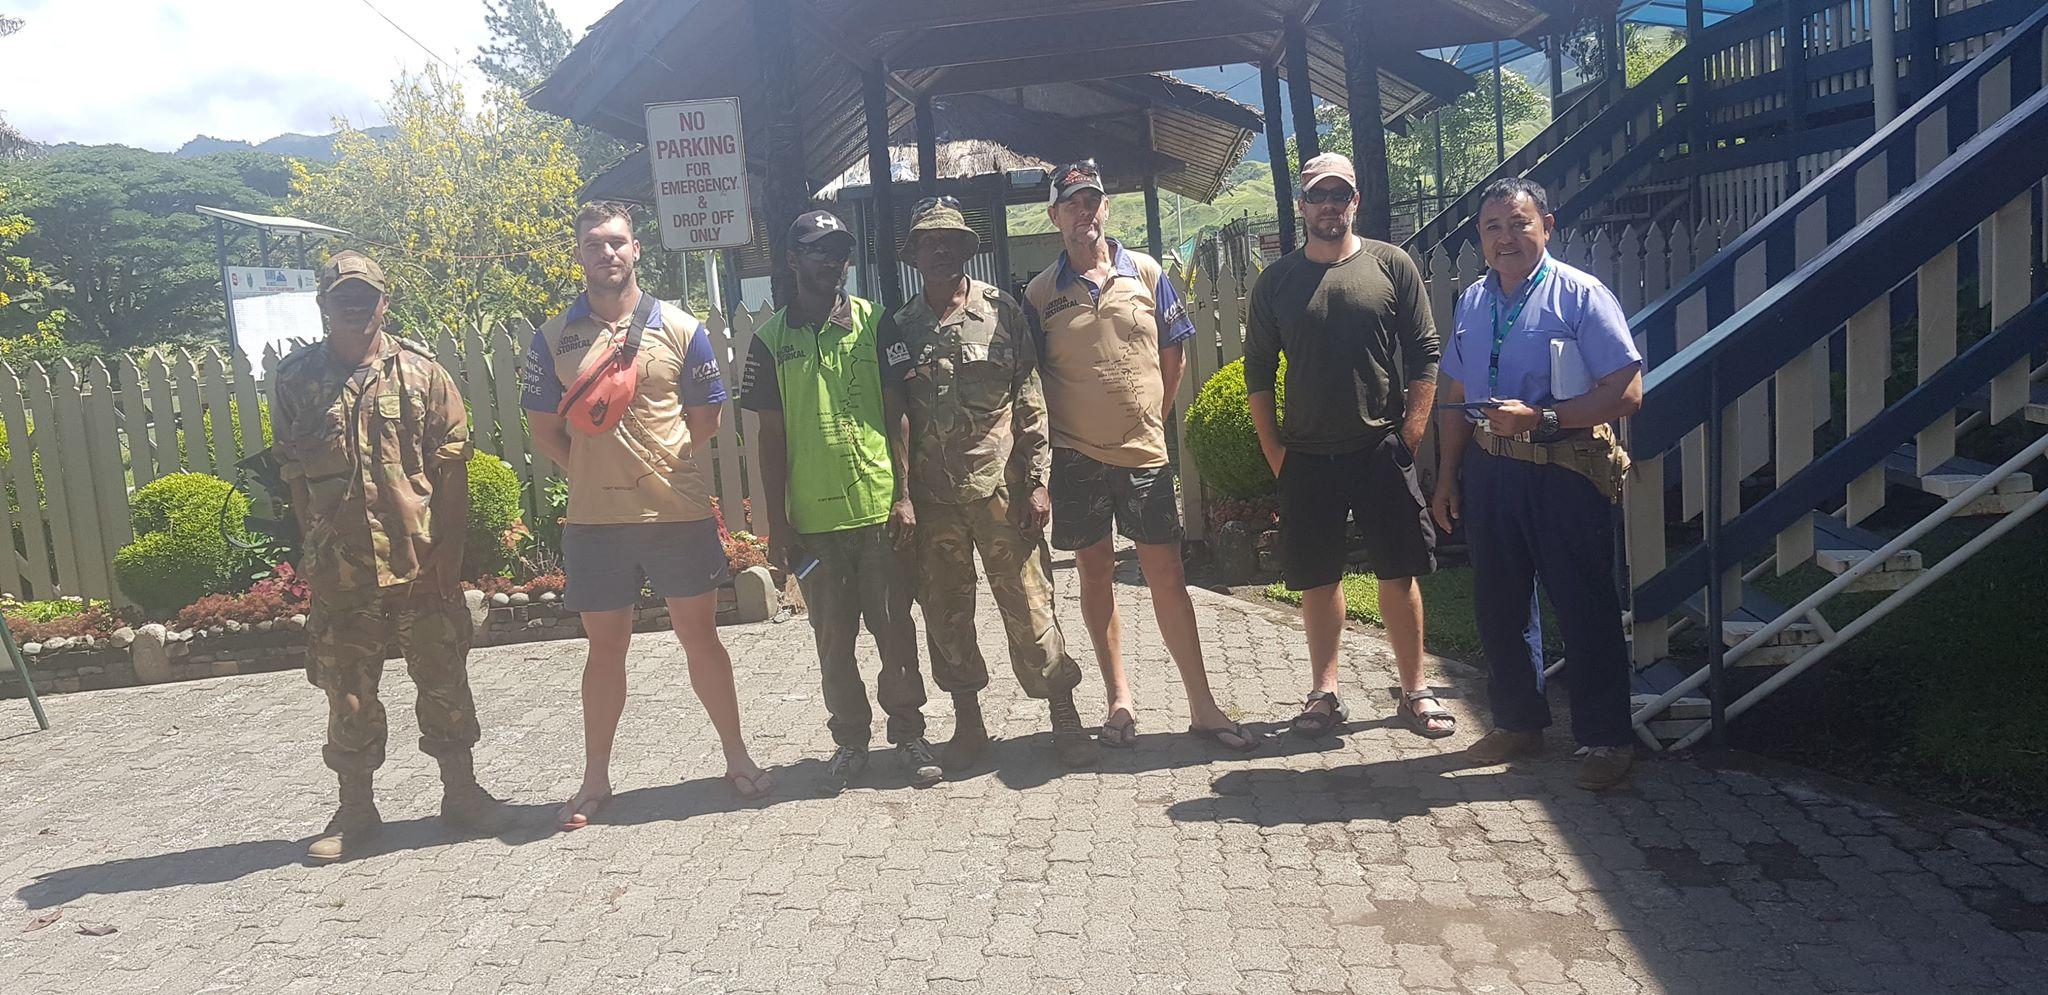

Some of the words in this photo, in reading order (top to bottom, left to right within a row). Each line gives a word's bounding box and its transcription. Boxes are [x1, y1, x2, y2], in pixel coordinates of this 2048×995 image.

[679, 111, 705, 131] NO
[656, 135, 736, 159] PARKING
[686, 162, 711, 177] FOR
[661, 176, 738, 195] EMERGENCY
[698, 195, 708, 209] &
[673, 212, 707, 228] DROP
[712, 210, 735, 225] OFF
[690, 227, 721, 243] ONLY
